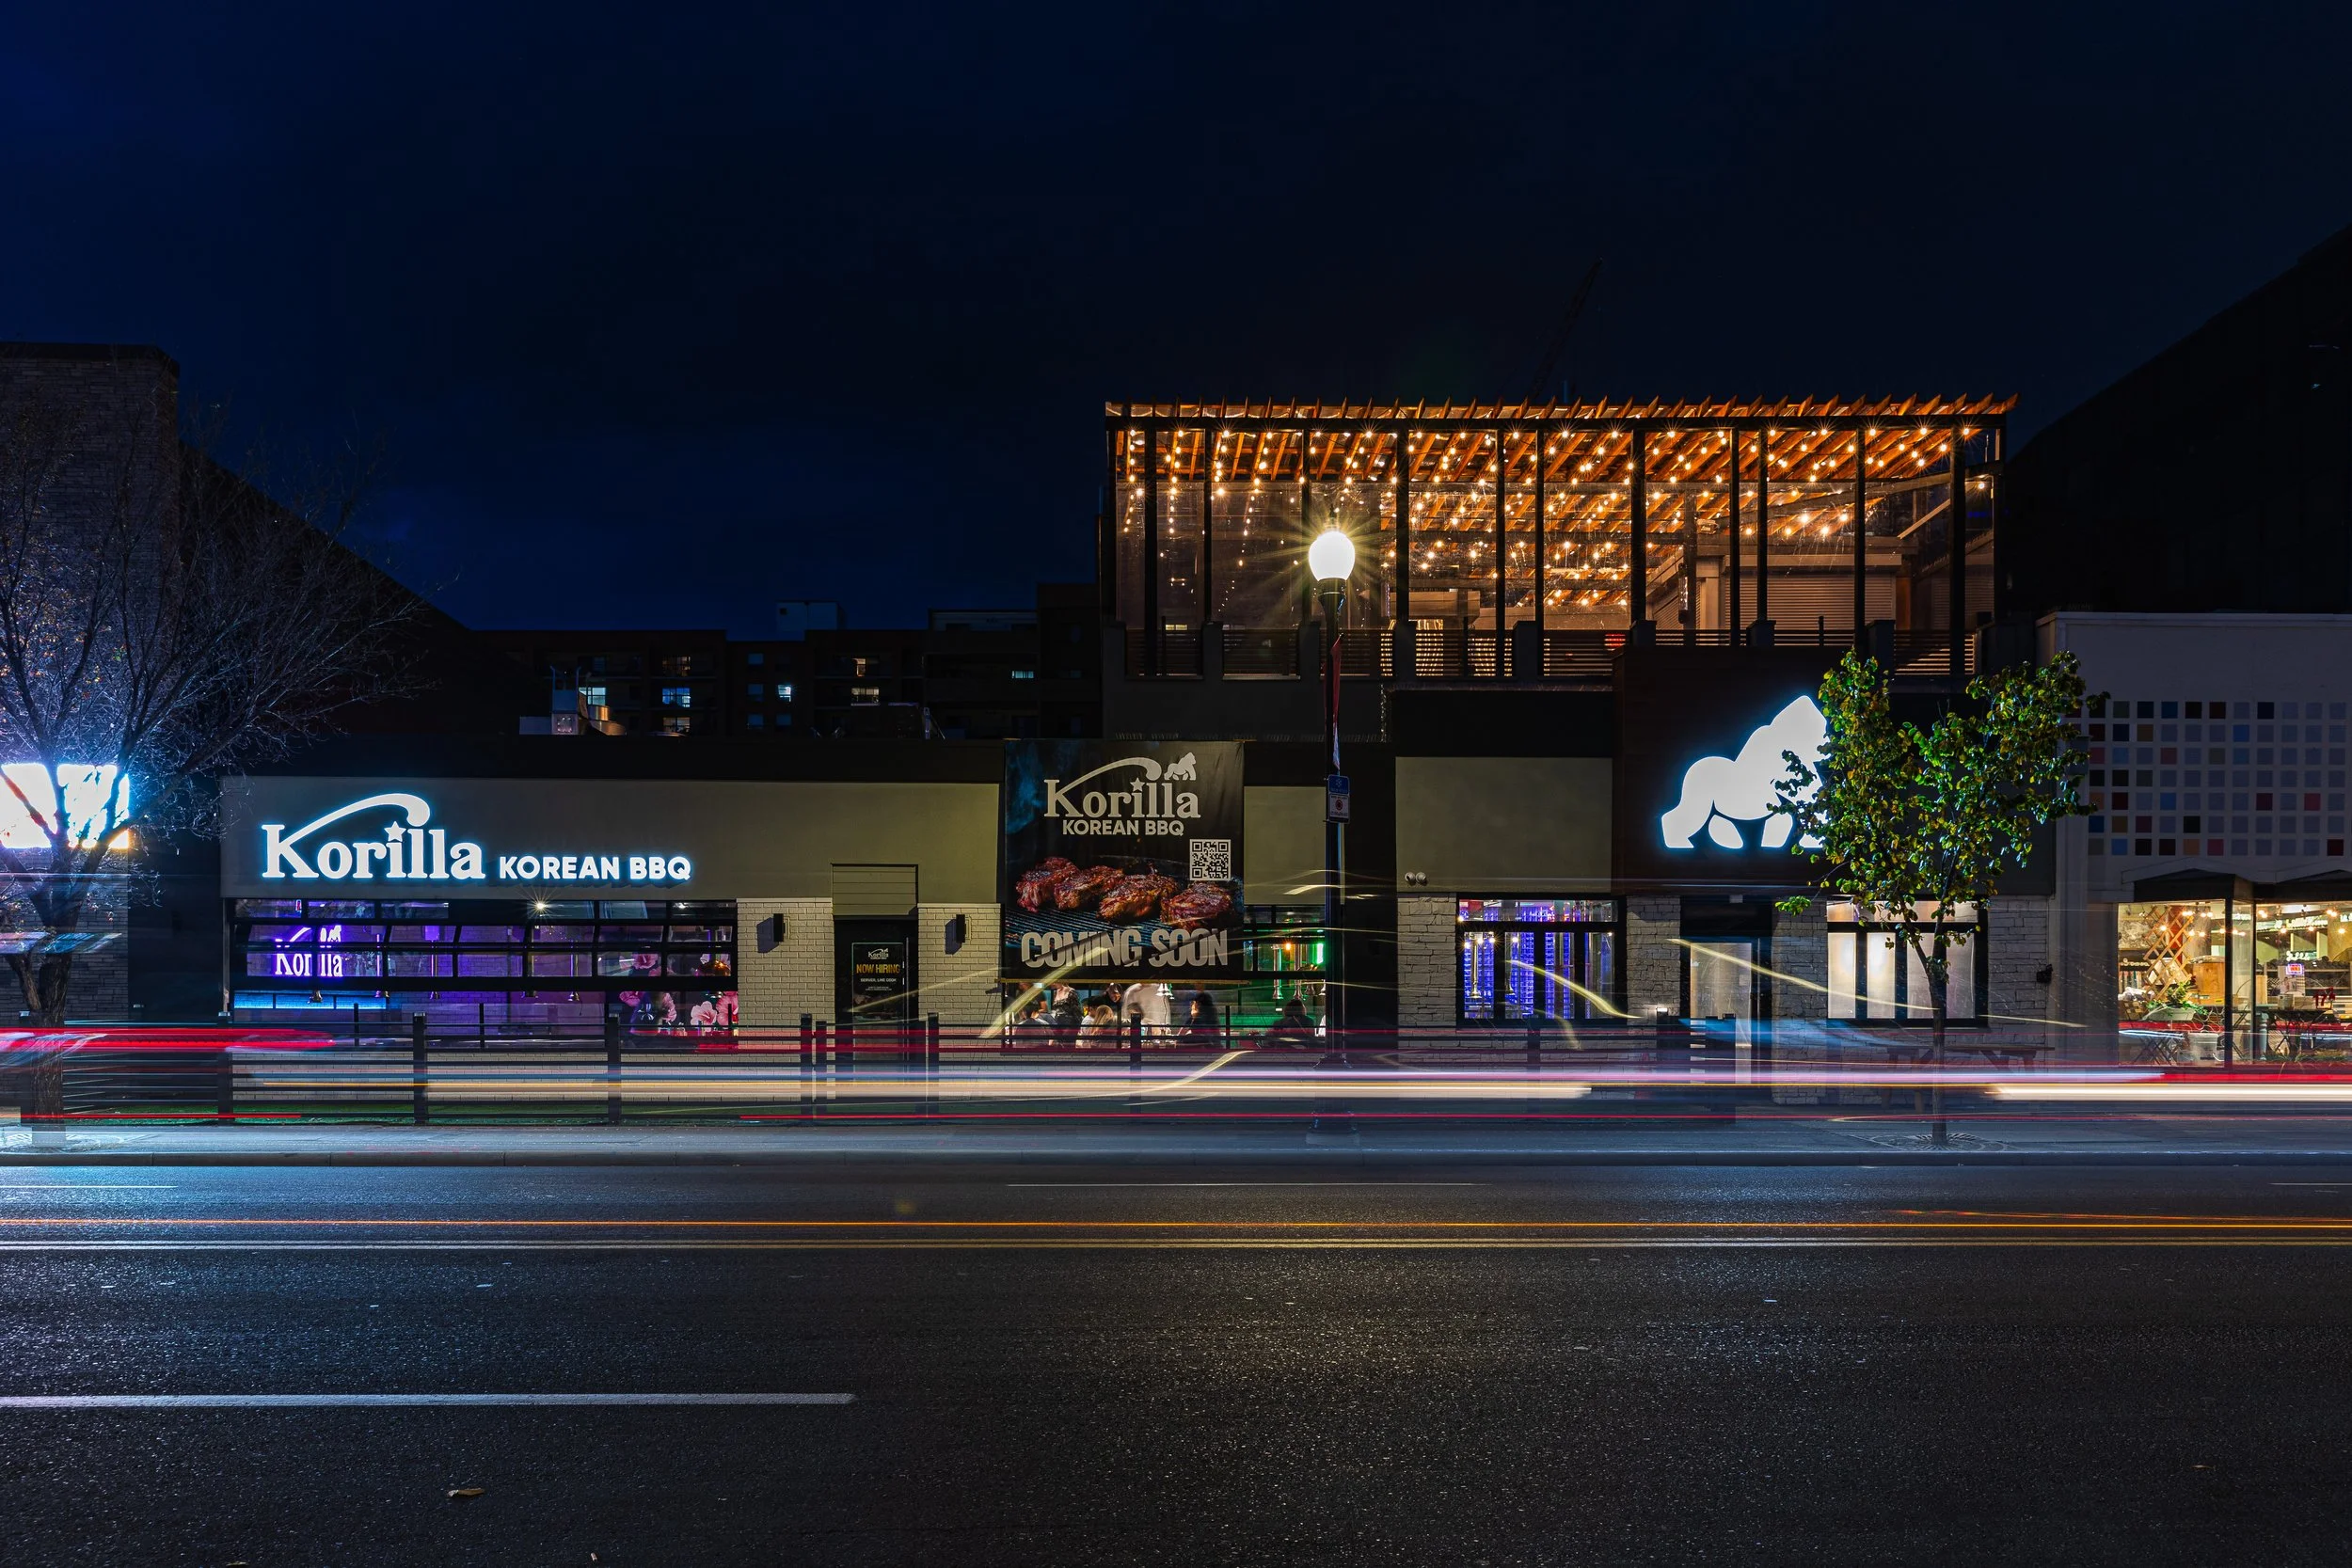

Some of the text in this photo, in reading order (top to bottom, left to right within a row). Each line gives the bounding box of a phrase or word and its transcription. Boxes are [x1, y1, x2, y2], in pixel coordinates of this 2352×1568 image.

[1043, 756, 1200, 819] Korilla
[261, 793, 486, 879] Korilla
[1062, 819, 1184, 836] KOREAN BBQ
[500, 855, 692, 881] KOREAN BBQ
[275, 927, 343, 976] Korlla
[1021, 927, 1229, 968] COMING SOON
[856, 963, 900, 974] NOW HIRING
